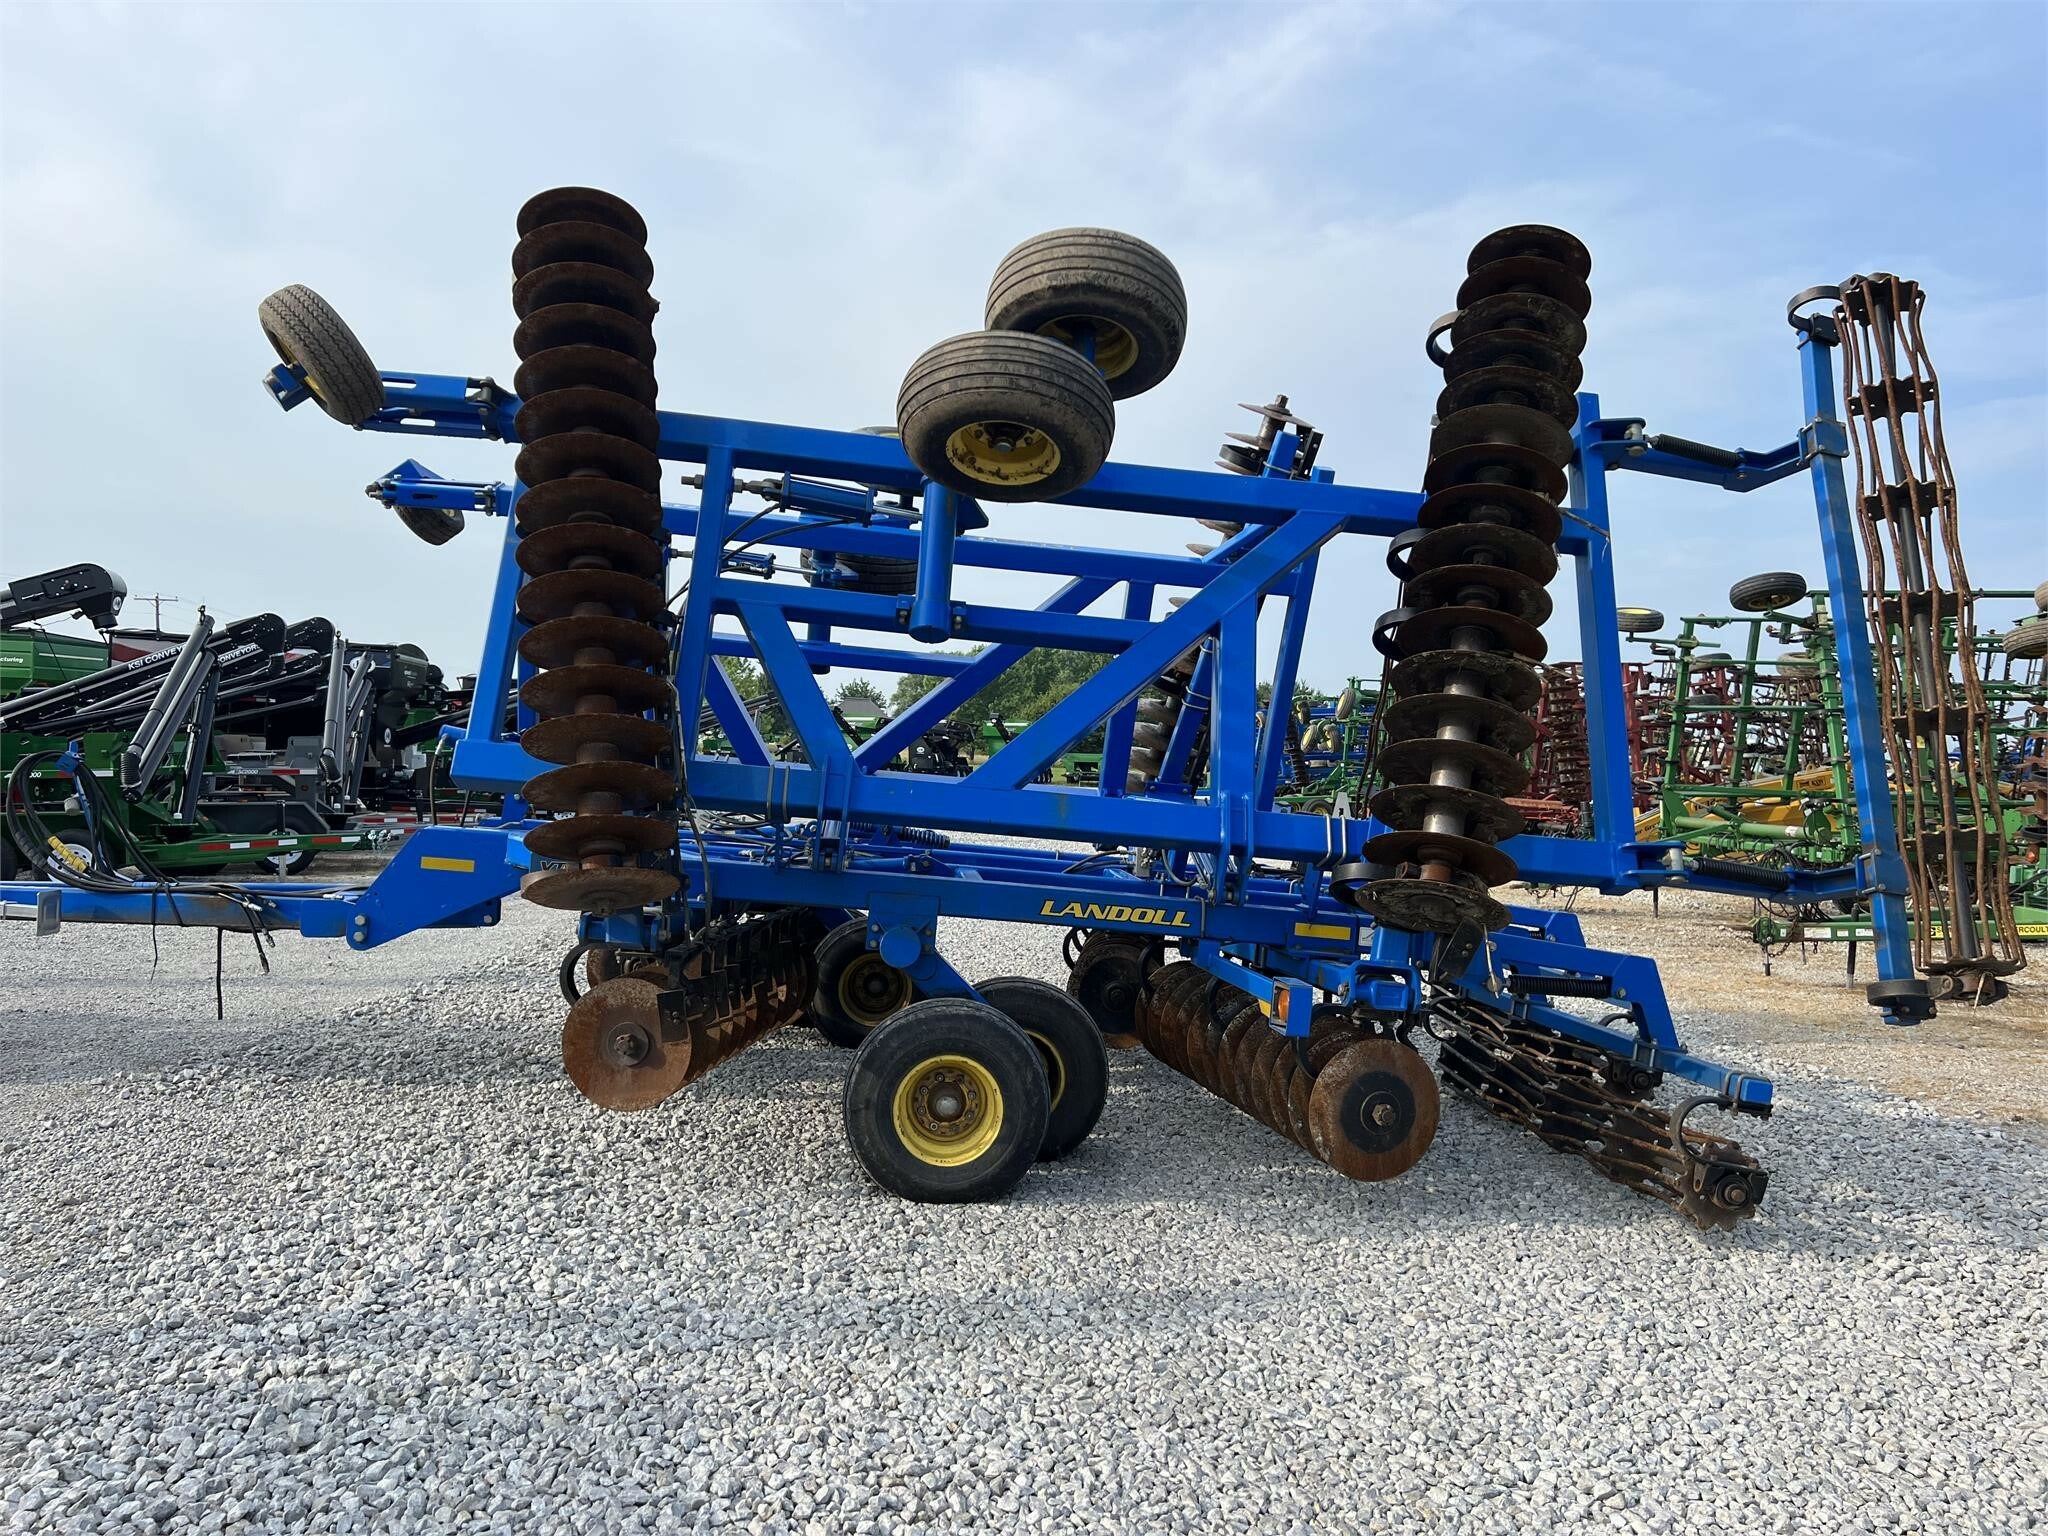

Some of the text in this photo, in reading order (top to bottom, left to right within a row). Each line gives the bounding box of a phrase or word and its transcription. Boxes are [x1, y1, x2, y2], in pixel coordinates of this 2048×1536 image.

[127, 644, 186, 671] KSI CONVEY
[1040, 900, 1191, 927] LANDOLL
